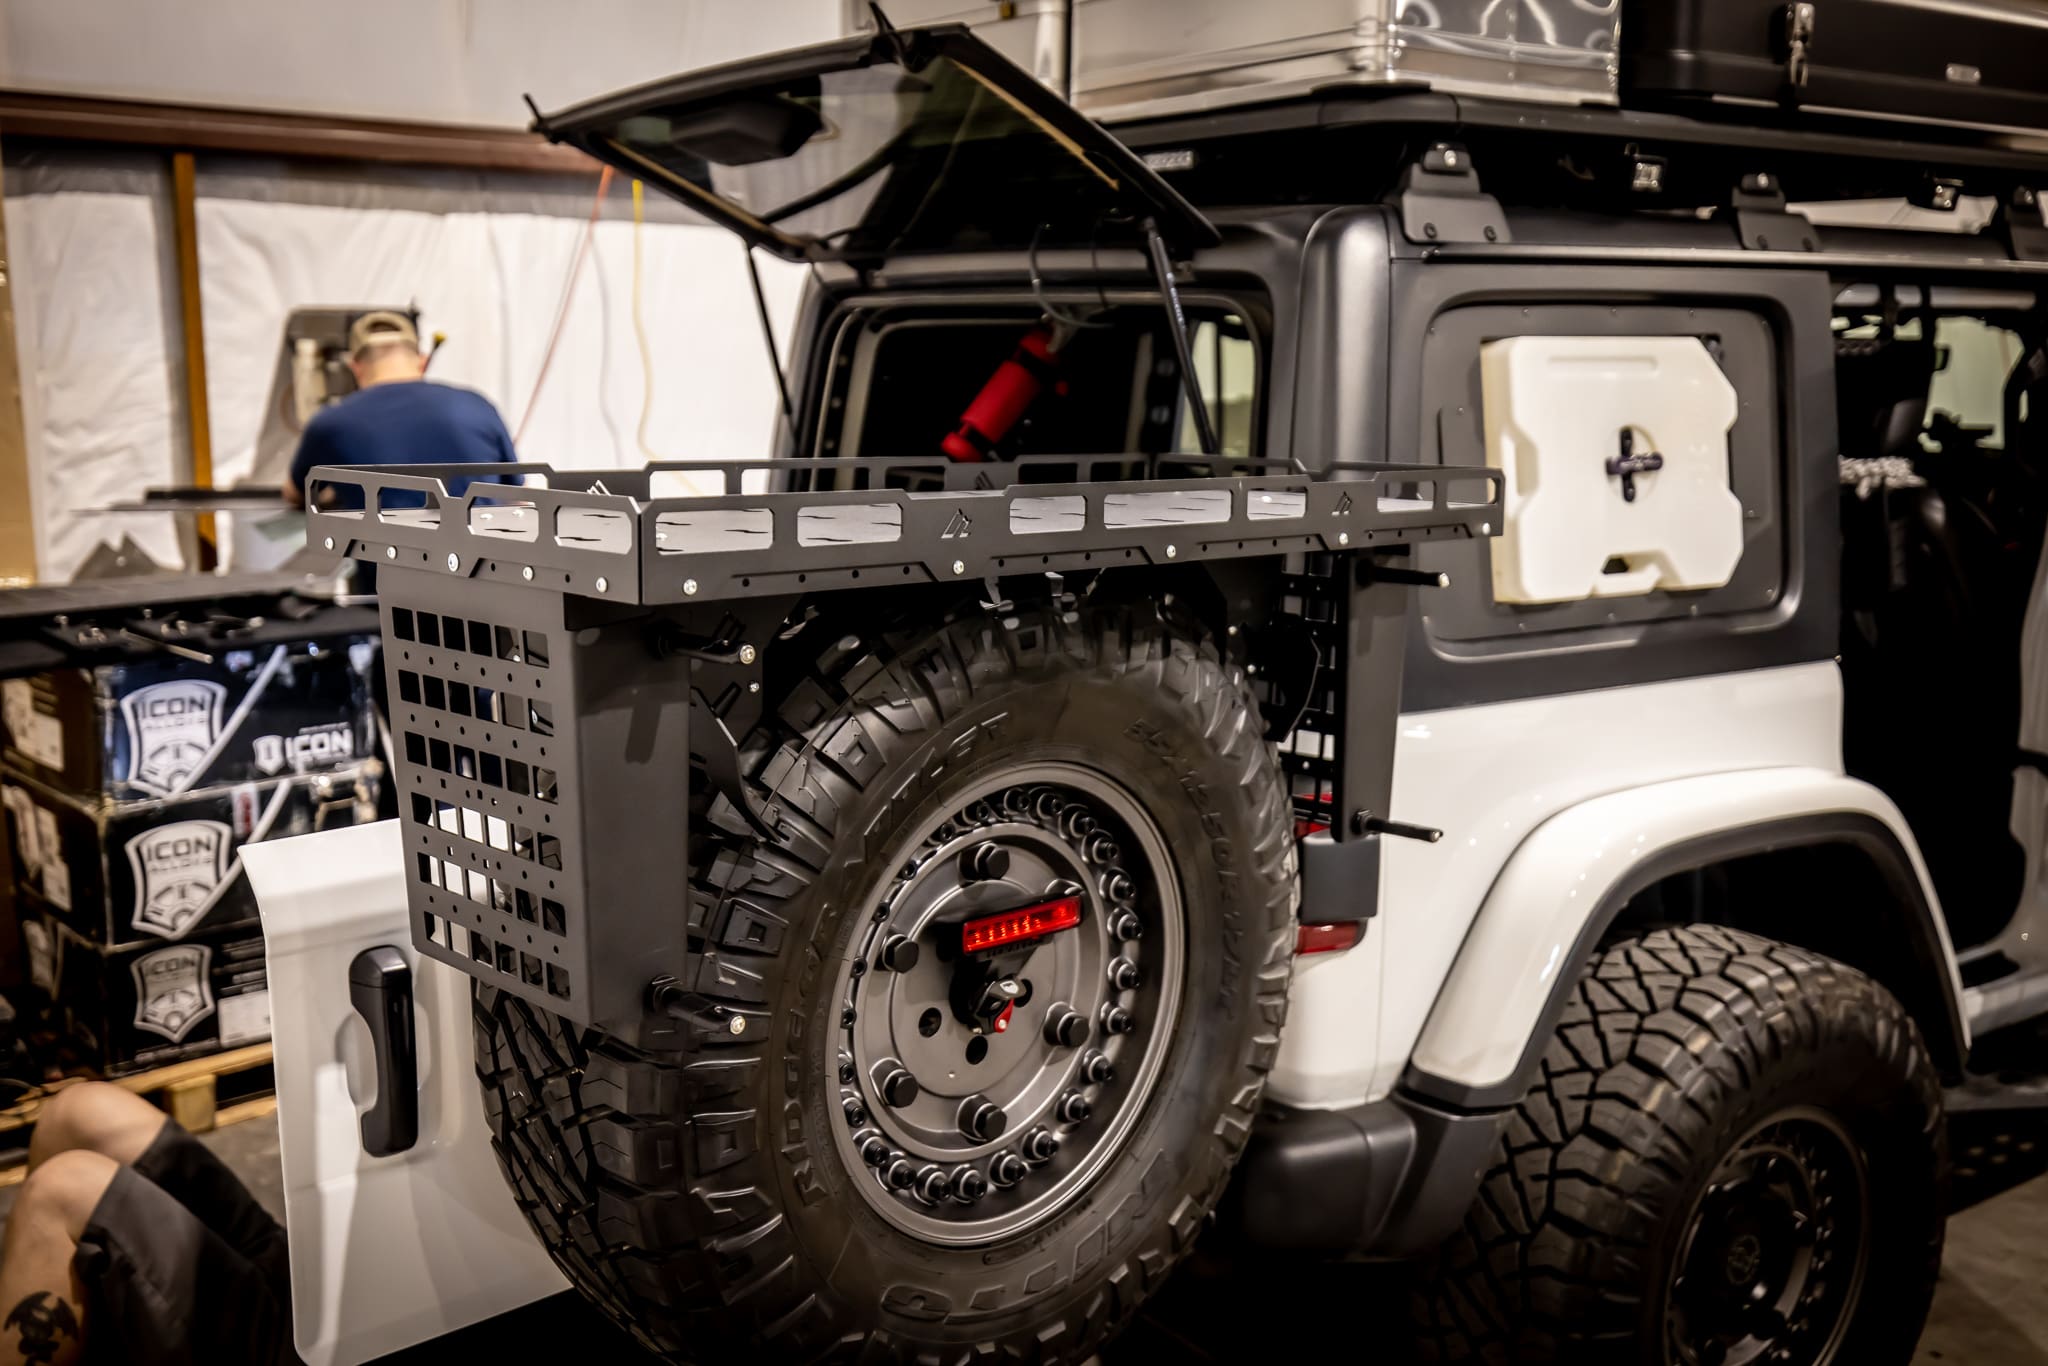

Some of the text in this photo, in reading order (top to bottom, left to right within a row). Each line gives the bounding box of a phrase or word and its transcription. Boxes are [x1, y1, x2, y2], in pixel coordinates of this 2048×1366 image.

[142, 696, 206, 719] ICON
[285, 729, 353, 760] ICON
[145, 836, 212, 862] ICON
[144, 956, 197, 977] ICON
